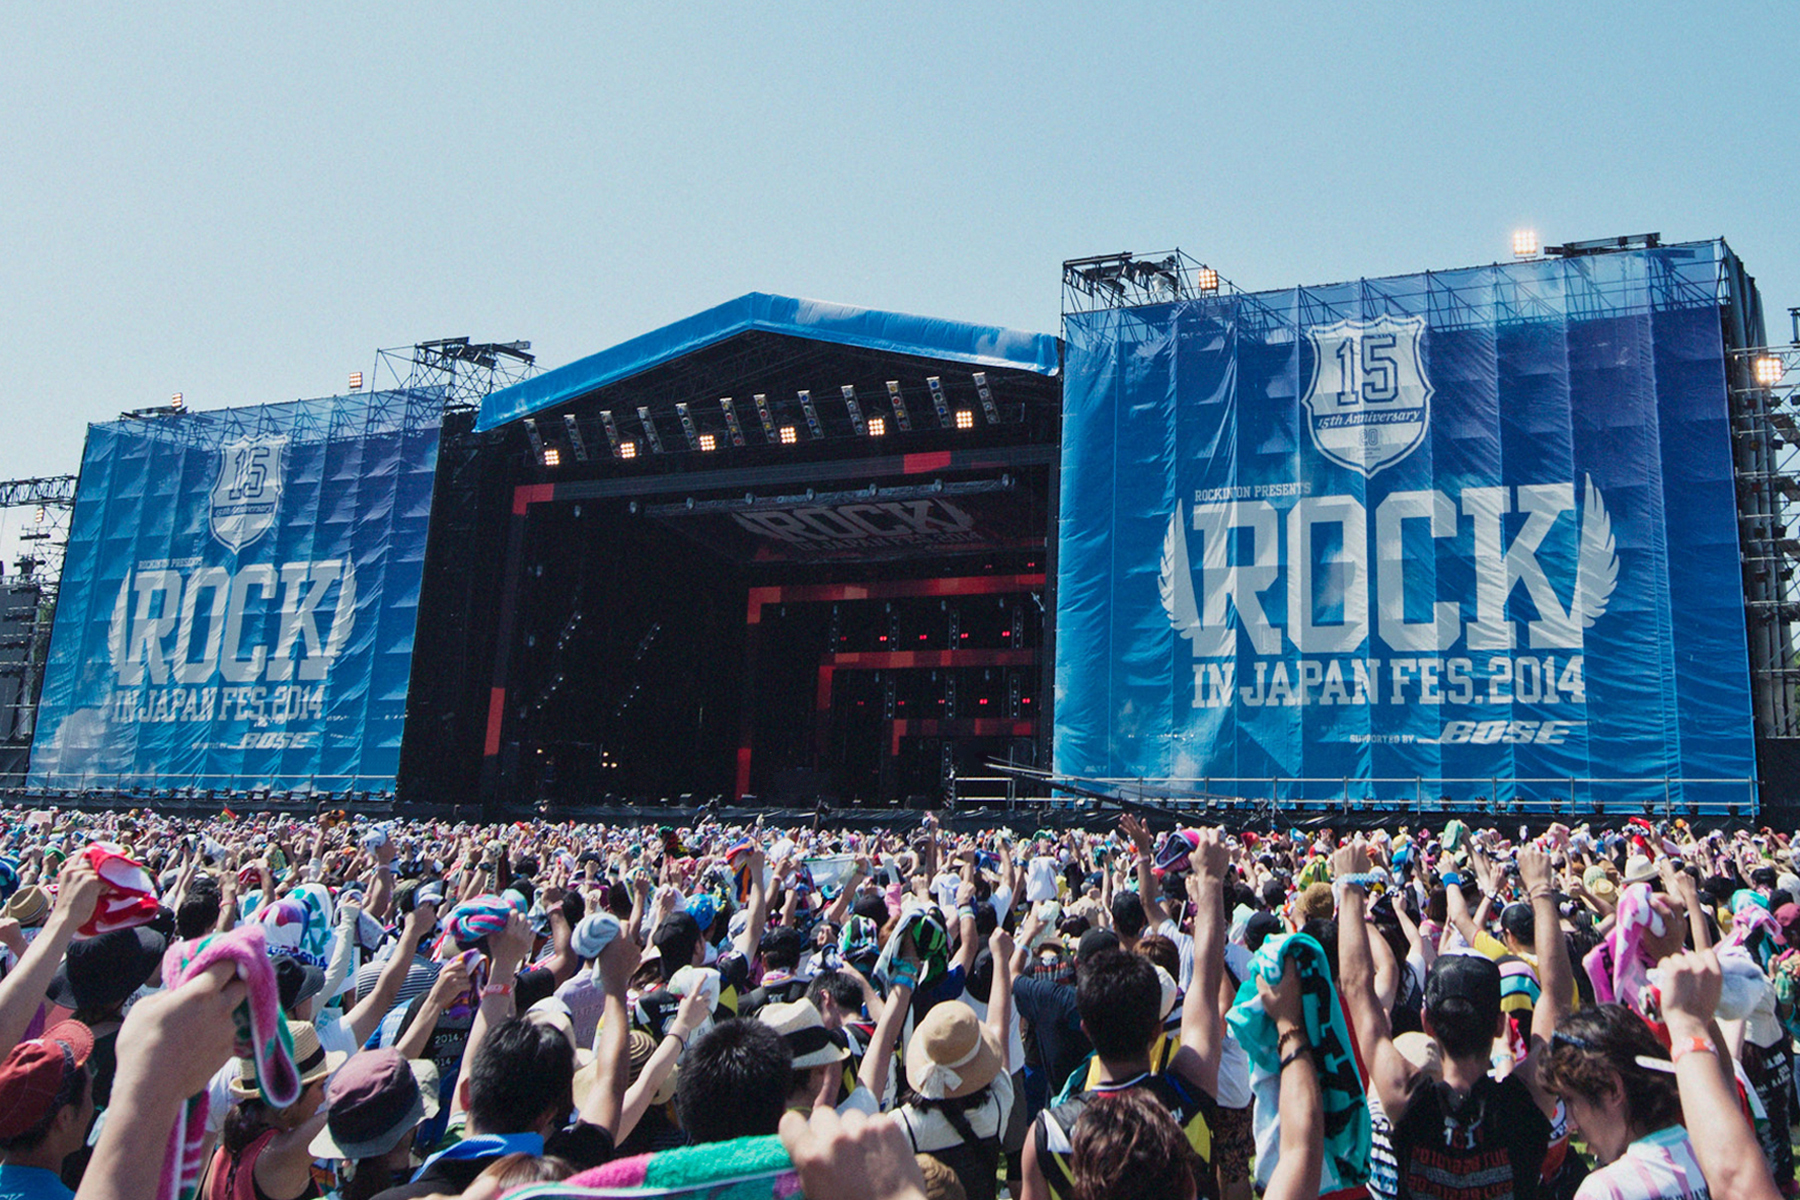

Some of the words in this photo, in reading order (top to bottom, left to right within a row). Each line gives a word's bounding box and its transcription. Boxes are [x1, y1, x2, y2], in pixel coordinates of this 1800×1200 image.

[1336, 334, 1398, 407] 15
[1318, 414, 1343, 430] 15th
[1344, 409, 1421, 426] Anniversary
[229, 446, 270, 500] 15
[1195, 486, 1251, 502] ROCKIN'ON
[1254, 482, 1311, 498] PRESENTS
[740, 499, 971, 543] ROCK
[1192, 484, 1585, 657] ROCK
[118, 559, 342, 686] ROCK
[1192, 661, 1236, 708] IN
[1239, 657, 1381, 706] JAPAN
[111, 688, 140, 723] IN
[139, 686, 218, 722] JAPAN
[227, 731, 320, 750] BOSE
[1350, 733, 1400, 744] SUPPORTED
[1402, 733, 1415, 744] BY
[1417, 720, 1588, 745] BOSE
